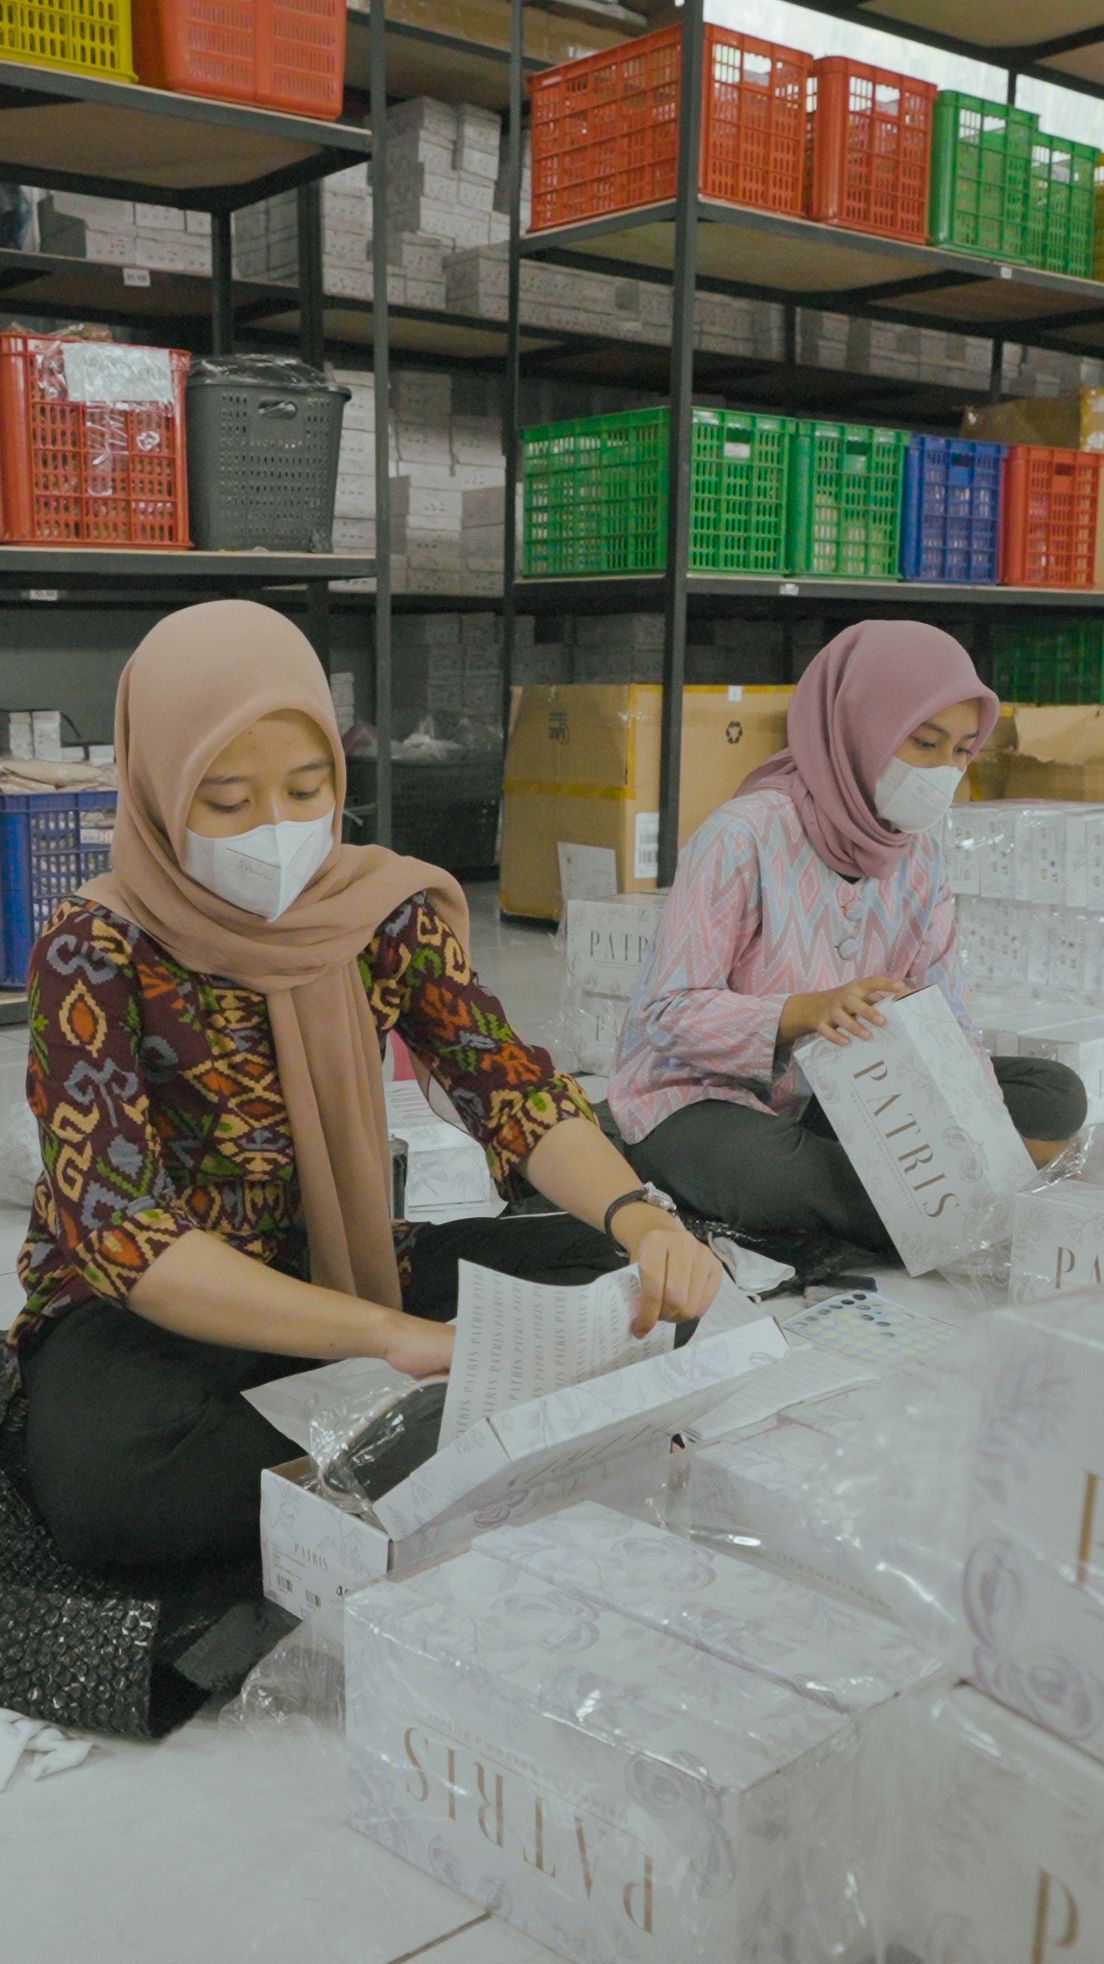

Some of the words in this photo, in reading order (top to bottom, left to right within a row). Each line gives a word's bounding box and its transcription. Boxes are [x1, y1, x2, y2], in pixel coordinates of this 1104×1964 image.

[853, 1060, 960, 1217] PATRIS
[1055, 1246, 1101, 1289] PA
[404, 1726, 654, 1937] PATRIS
